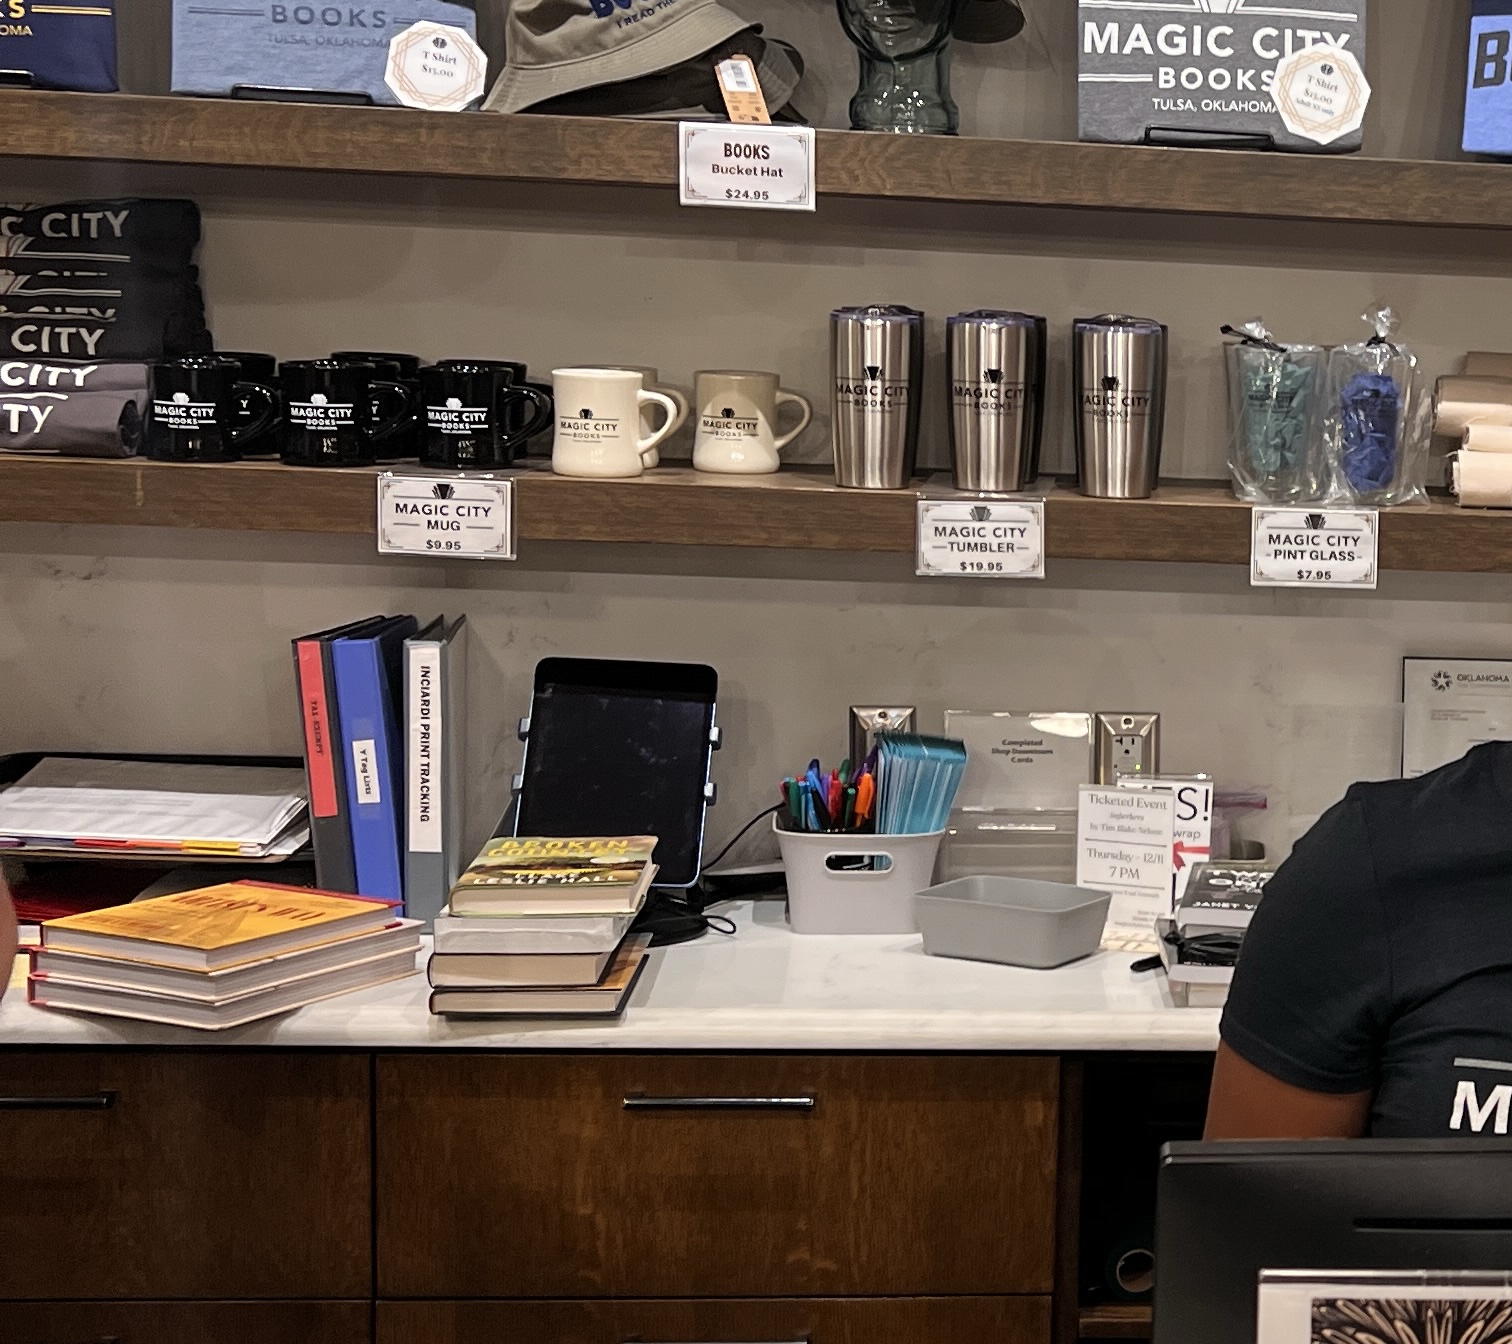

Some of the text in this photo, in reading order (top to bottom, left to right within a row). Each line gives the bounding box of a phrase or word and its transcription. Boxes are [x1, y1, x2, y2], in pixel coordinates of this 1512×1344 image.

[624, 7, 655, 27] READ
[724, 142, 770, 160] BOOKS
[711, 164, 784, 178] Bucket Hat
[725, 188, 770, 200] $24.95
[41, 210, 130, 239] CITY
[395, 503, 492, 518] MAGIC CITY
[427, 520, 461, 531] MUG
[425, 539, 462, 551] $9.95
[947, 542, 1016, 554] TUMBLER
[1273, 550, 1356, 562] PINT GLASS
[959, 561, 1004, 573] $19.95
[1297, 569, 1332, 580] $7.95
[1456, 673, 1510, 682] OKLAHOMA
[420, 665, 431, 823] INCIARDI PRINT TRACKING
[1088, 793, 1168, 811] Ticketed Event
[1086, 848, 1134, 863] Thursday
[1109, 866, 1140, 880] 7 PM
